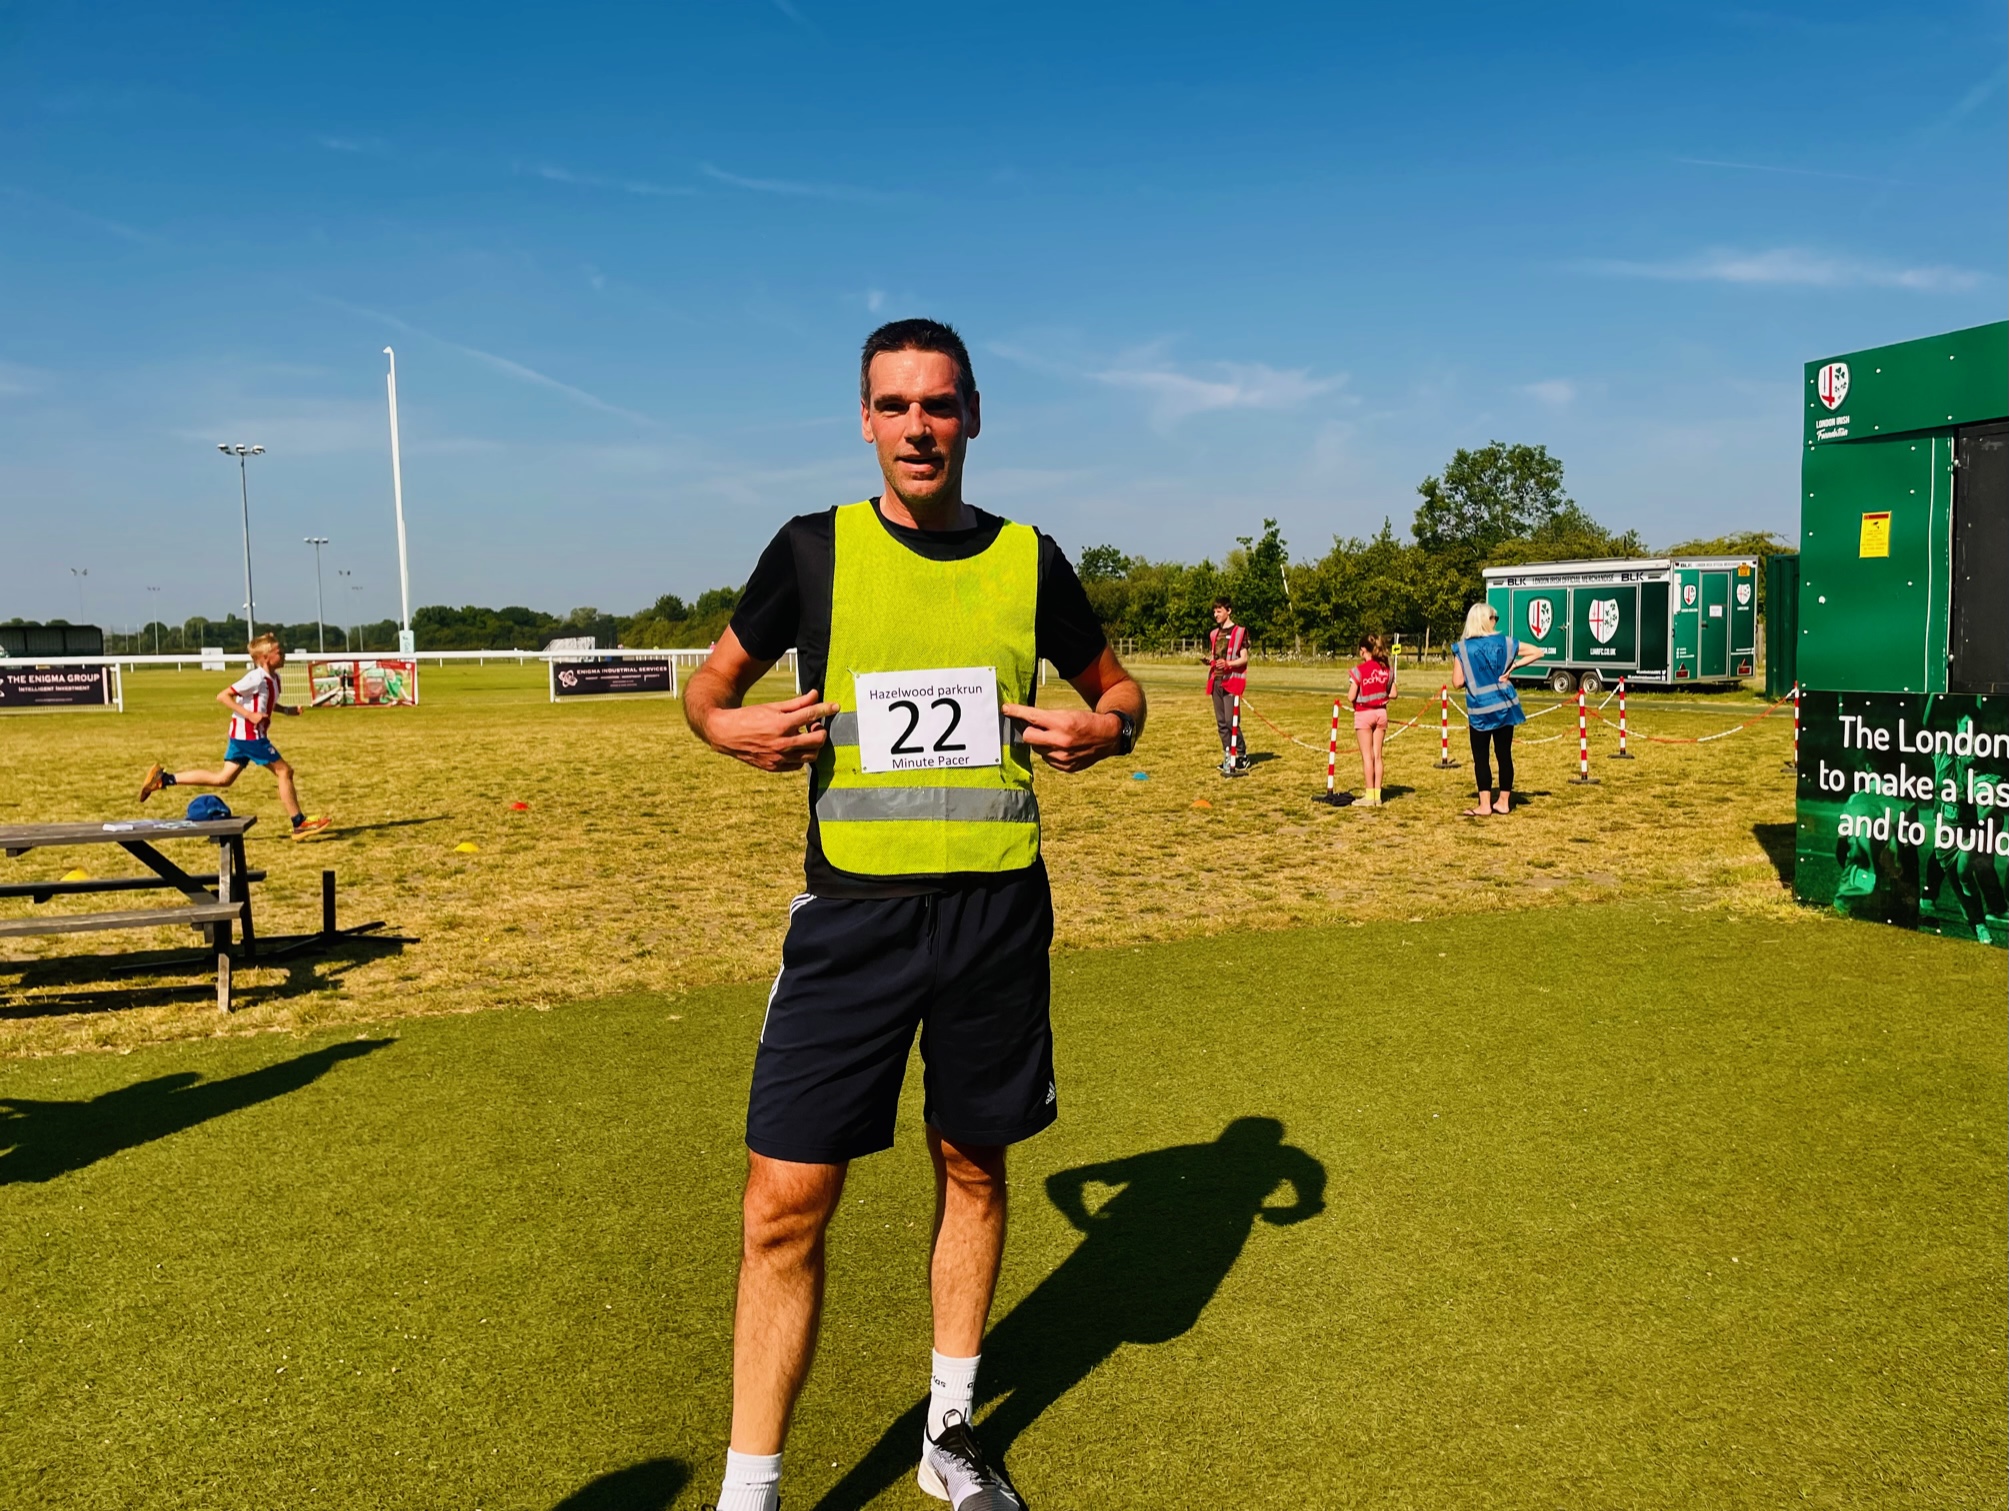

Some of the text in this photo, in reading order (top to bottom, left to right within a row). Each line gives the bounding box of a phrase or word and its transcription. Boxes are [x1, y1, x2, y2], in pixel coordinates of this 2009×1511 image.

[1816, 415, 1850, 429] LONDON IRISH
[1507, 577, 1526, 586] BLK
[1621, 572, 1644, 582] BLK
[7, 673, 100, 684] THE ENIGMA GROUP
[870, 684, 982, 700] Hazelwood parkrun
[888, 697, 967, 755] 22
[1838, 715, 2009, 758] The London
[892, 755, 970, 769] Minute Pacer
[1819, 759, 1846, 792] to
[1853, 762, 1934, 800] make
[1941, 779, 1957, 803] a
[1837, 807, 1891, 841] and
[1897, 810, 1926, 846] to
